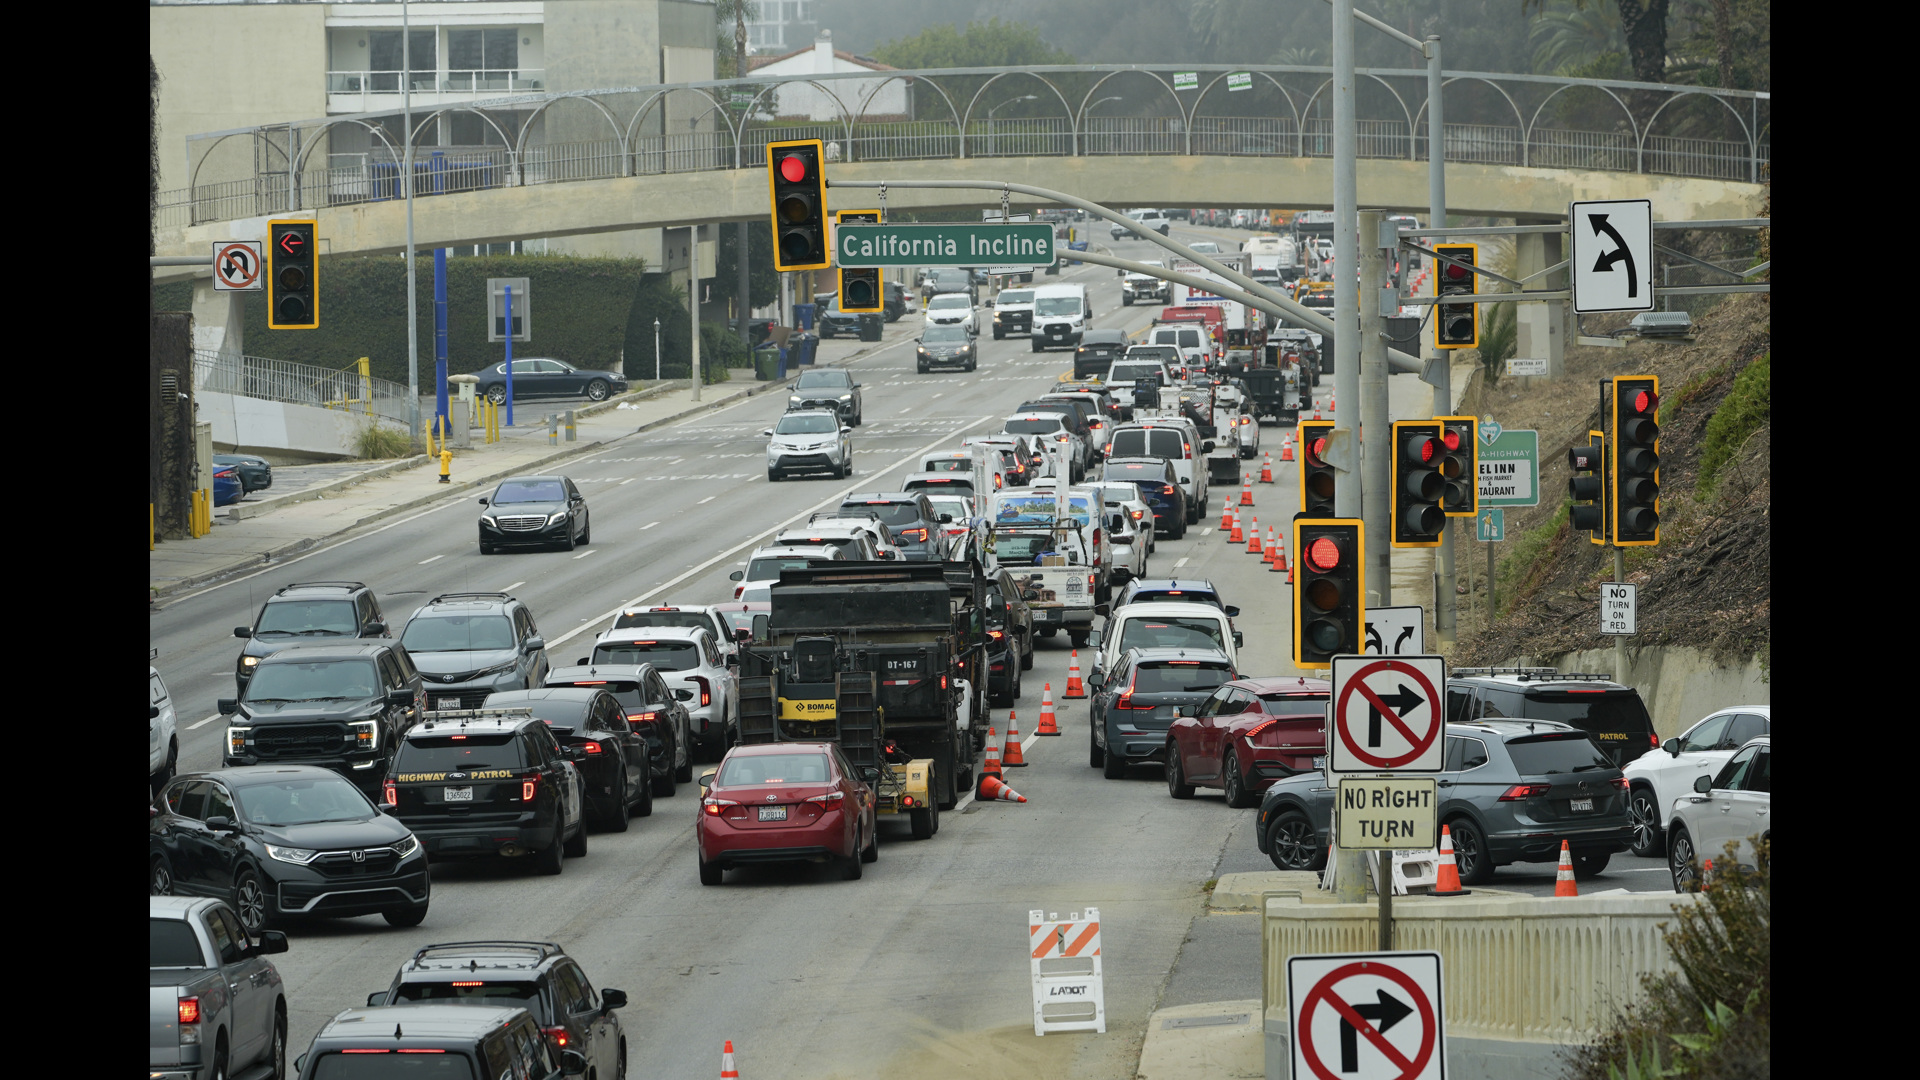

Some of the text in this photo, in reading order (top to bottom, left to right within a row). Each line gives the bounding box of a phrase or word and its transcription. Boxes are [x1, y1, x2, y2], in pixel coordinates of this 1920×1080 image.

[843, 233, 1048, 257] California Incline
[1494, 463, 1515, 474] INN
[1478, 486, 1515, 496] TAURANT
[1610, 588, 1627, 598] NO
[1608, 600, 1630, 609] TURN
[1612, 611, 1624, 619] ON
[1610, 621, 1626, 630] RED
[887, 660, 917, 669] DT-167
[398, 773, 447, 782] HIGHWAY
[470, 770, 513, 779] PATROL
[446, 791, 471, 800] 1365022
[1345, 788, 1432, 809] NO RIGHT
[1359, 820, 1414, 837] TURN
